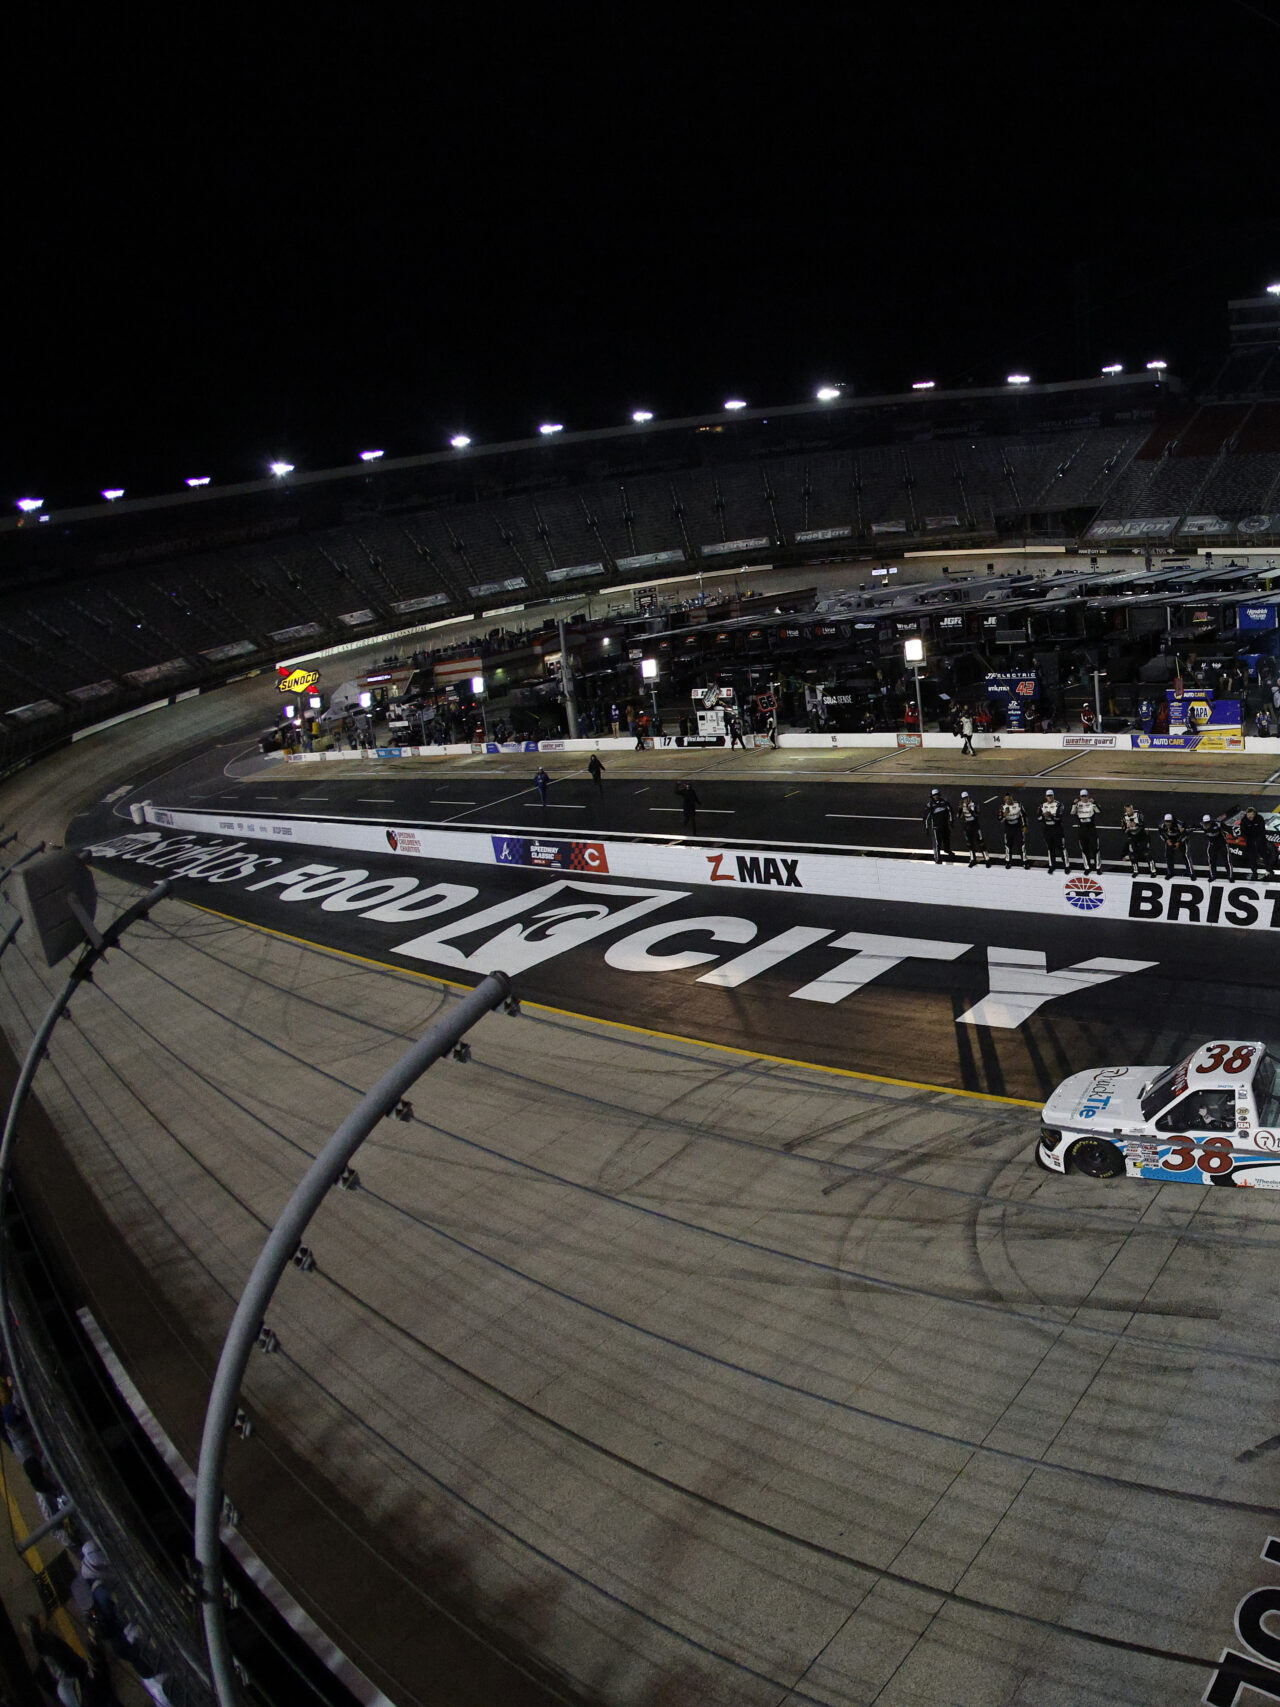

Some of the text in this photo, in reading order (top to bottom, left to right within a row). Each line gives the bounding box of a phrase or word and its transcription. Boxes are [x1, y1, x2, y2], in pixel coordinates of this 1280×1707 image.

[940, 616, 962, 625] JGR
[281, 672, 319, 691] SUNOCO
[1016, 681, 1035, 696] 42
[663, 737, 672, 747] 17
[993, 735, 1001, 743] 14
[1065, 736, 1114, 747] weather guard
[1168, 738, 1185, 746] CARE
[530, 845, 559, 854] SPEEDWAY
[531, 851, 555, 860] CLASSIC
[245, 863, 1161, 1030] FOOD CITY
[1195, 1044, 1257, 1075] 38
[1079, 1066, 1129, 1119] QuickTie
[1161, 1135, 1234, 1174] 38
